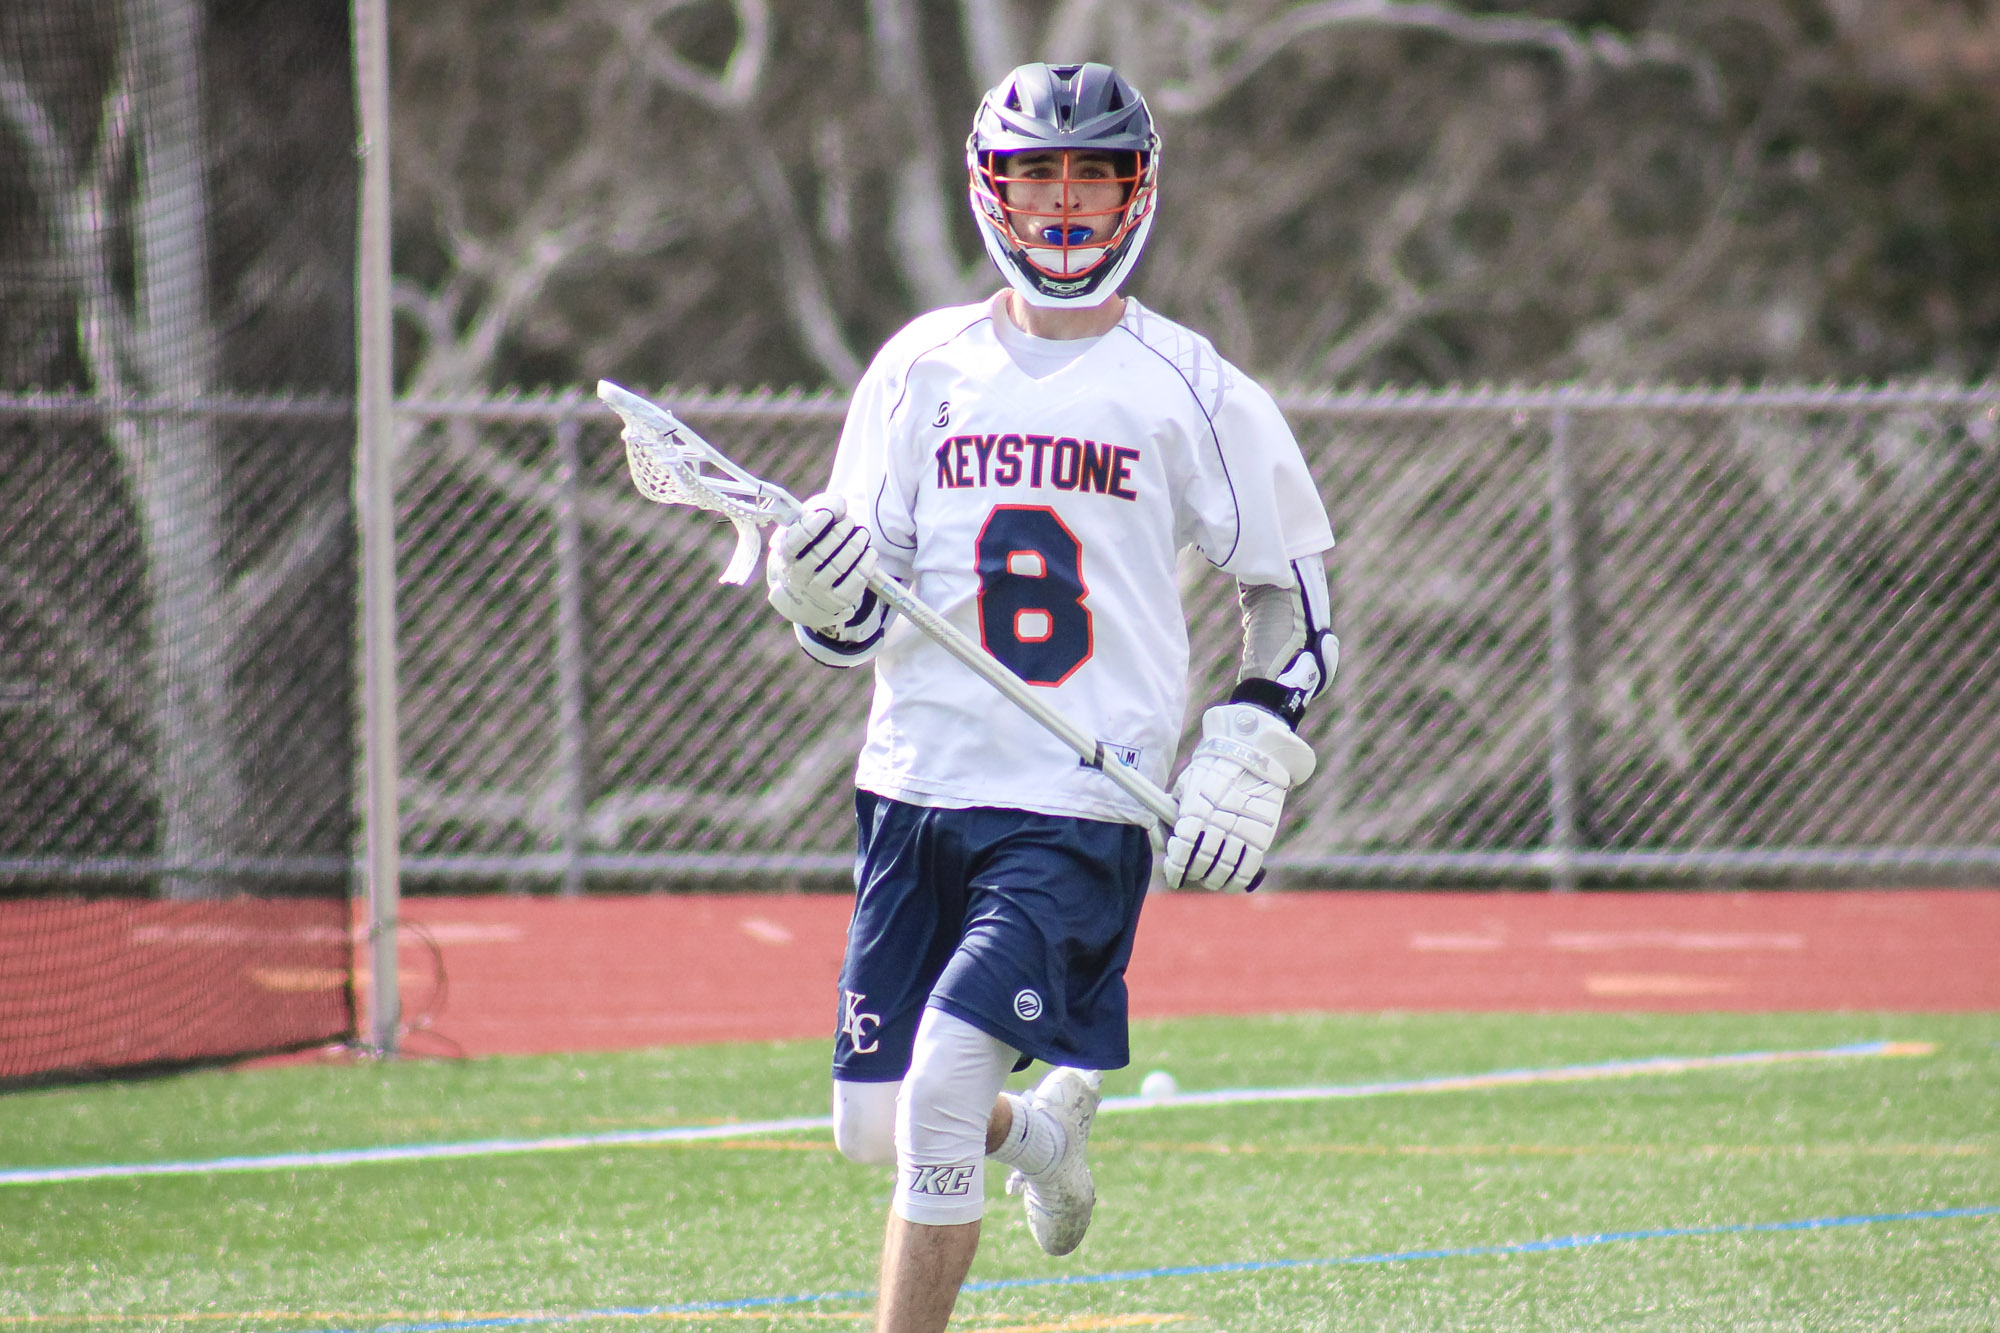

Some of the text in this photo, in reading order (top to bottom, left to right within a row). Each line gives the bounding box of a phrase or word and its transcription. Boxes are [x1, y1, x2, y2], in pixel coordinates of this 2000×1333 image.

[935, 434, 1141, 501] KEYSTONE
[974, 504, 1093, 688] 8
[1125, 751, 1136, 764] M
[909, 1165, 976, 1196] KC
